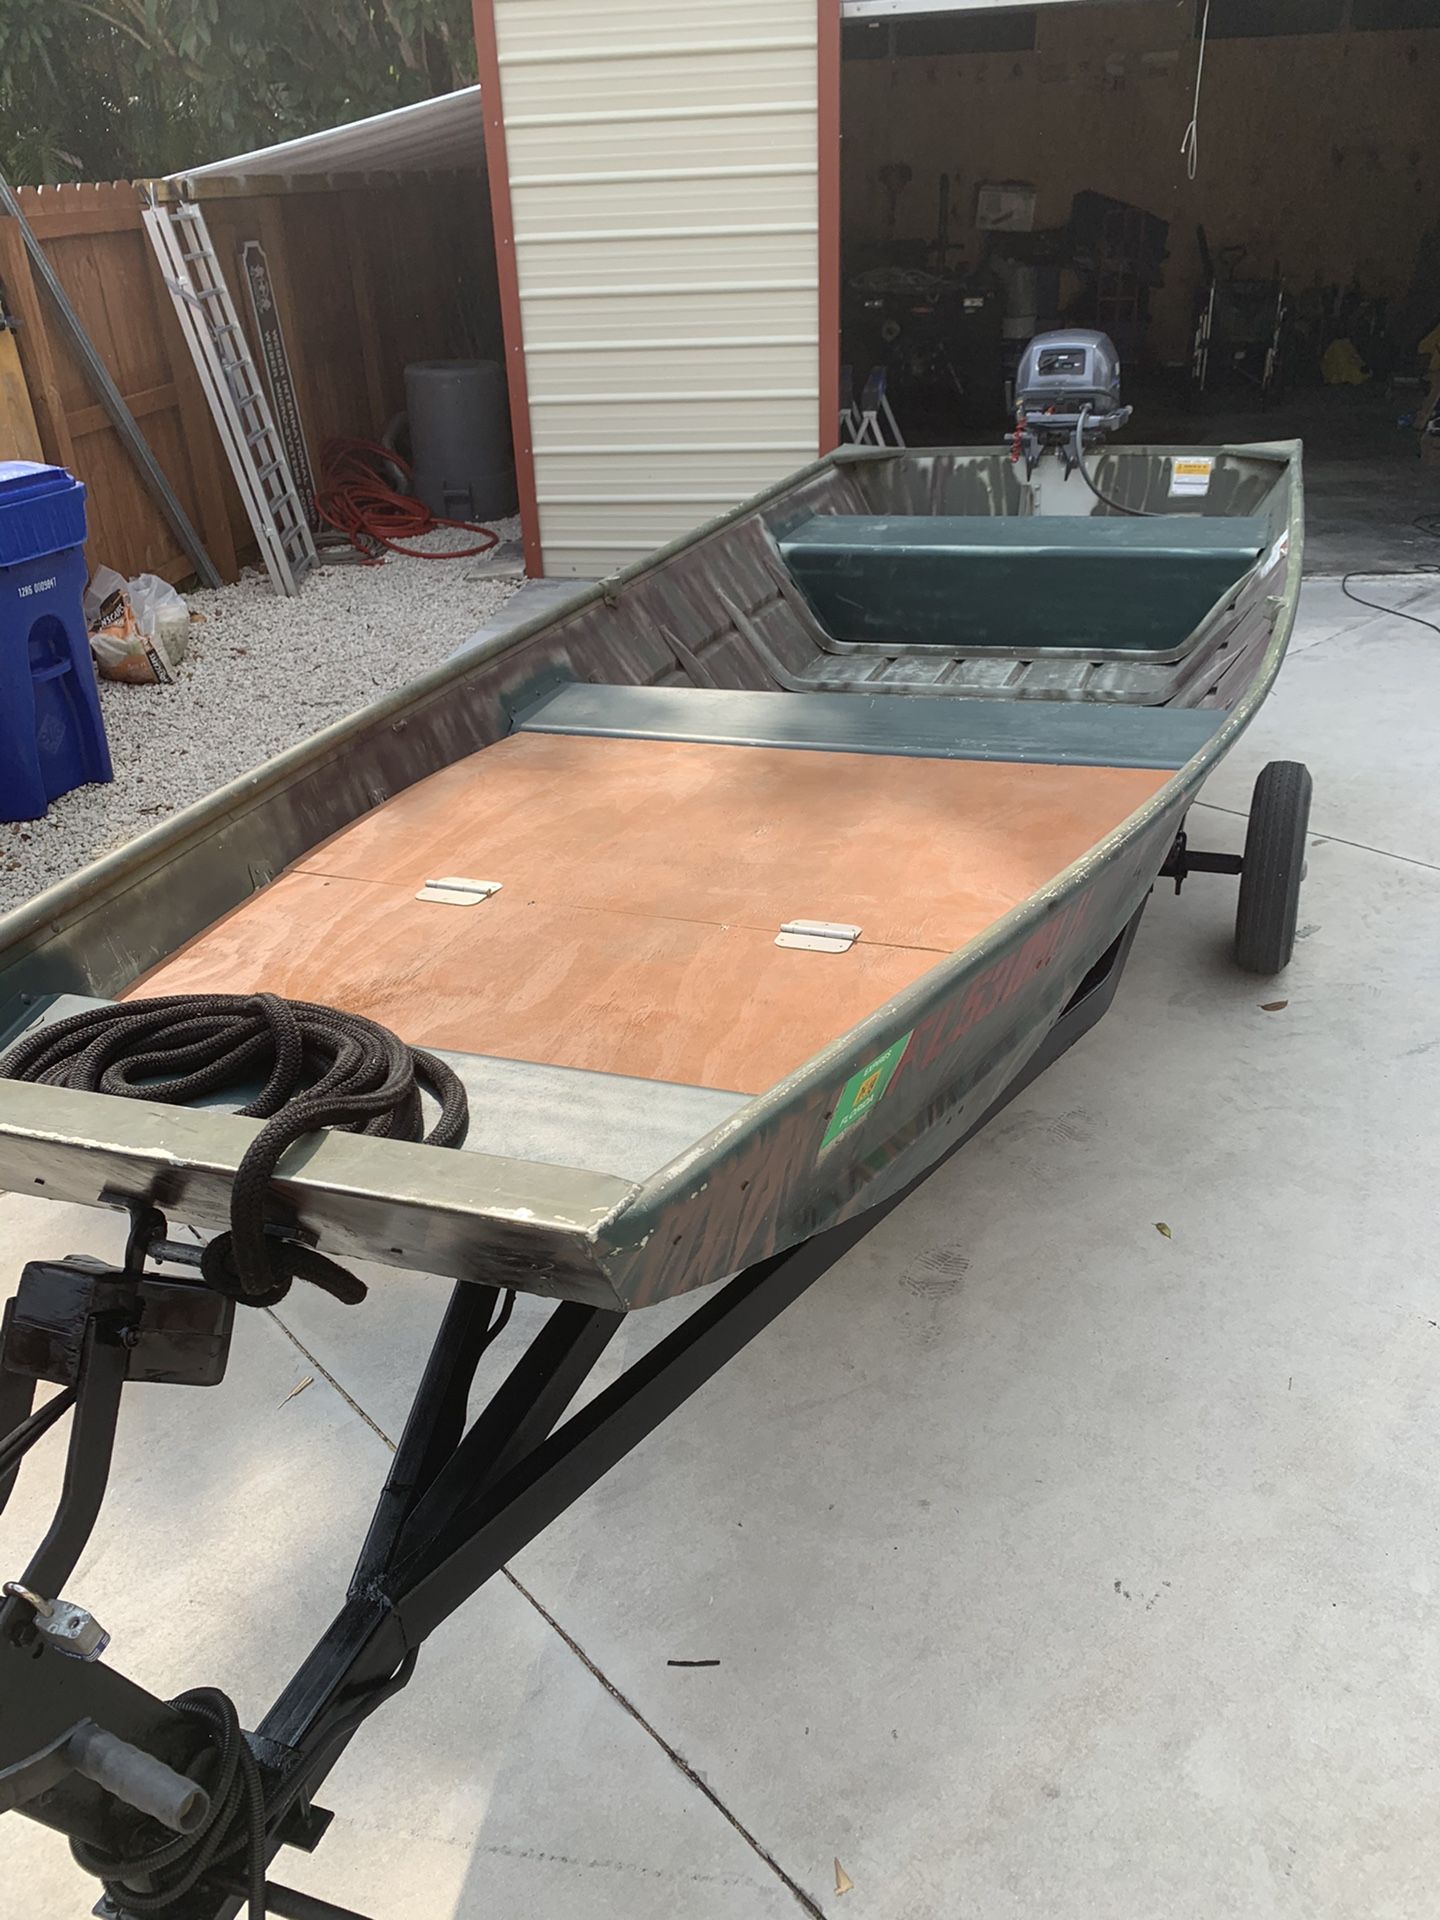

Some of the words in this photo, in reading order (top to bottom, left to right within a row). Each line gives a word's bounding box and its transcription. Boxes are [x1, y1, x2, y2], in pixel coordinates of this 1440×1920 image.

[265, 330, 278, 378] WEBER
[272, 329, 285, 377] WEBER
[281, 380, 308, 485] INTERNATIONAL
